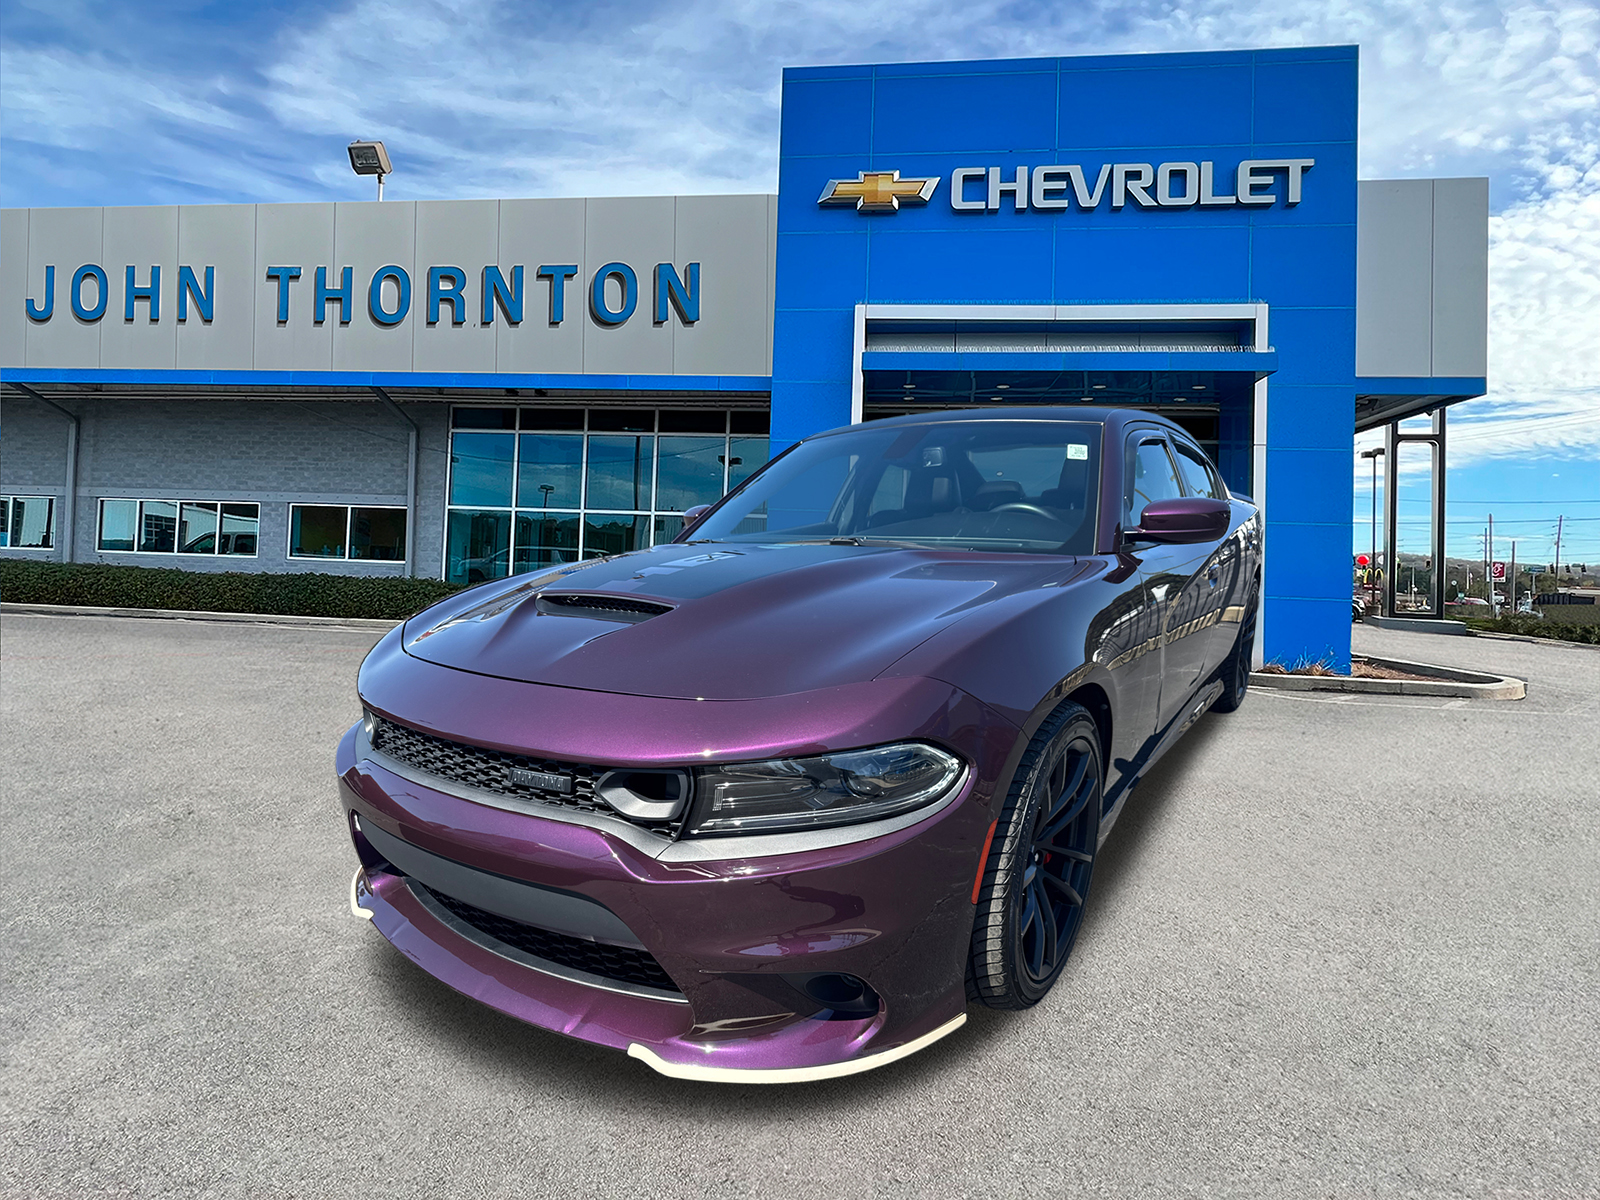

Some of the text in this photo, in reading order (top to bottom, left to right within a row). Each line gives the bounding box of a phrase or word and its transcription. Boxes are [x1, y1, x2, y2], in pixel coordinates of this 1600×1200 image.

[951, 158, 1316, 212] CHEVROLET
[25, 262, 701, 327] JOHN THORNTON
[512, 770, 565, 791] DAYTONA
